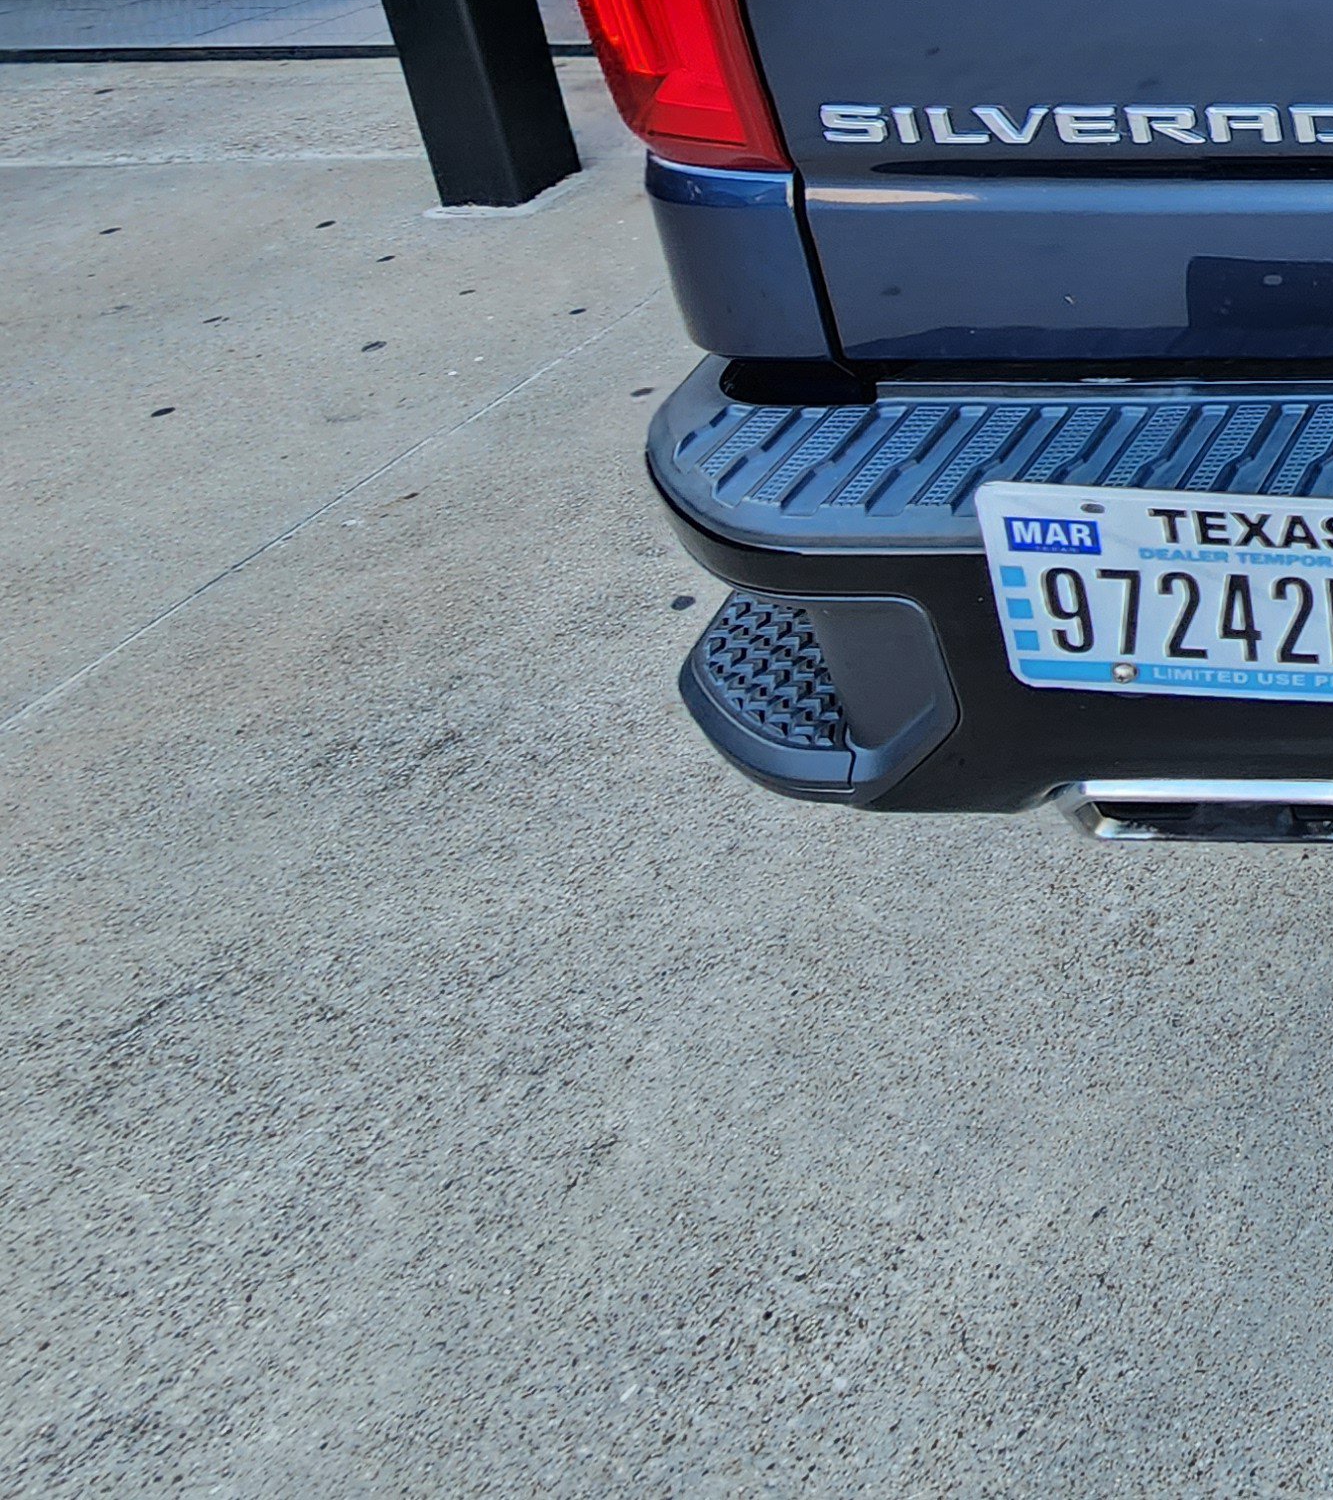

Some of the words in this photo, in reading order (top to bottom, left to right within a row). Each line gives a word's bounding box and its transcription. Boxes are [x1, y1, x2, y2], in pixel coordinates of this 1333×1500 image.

[1011, 520, 1093, 547] MAR
[1139, 547, 1229, 563] DEALER
[1153, 667, 1248, 684] LIMITED
[1257, 672, 1305, 687] USE
